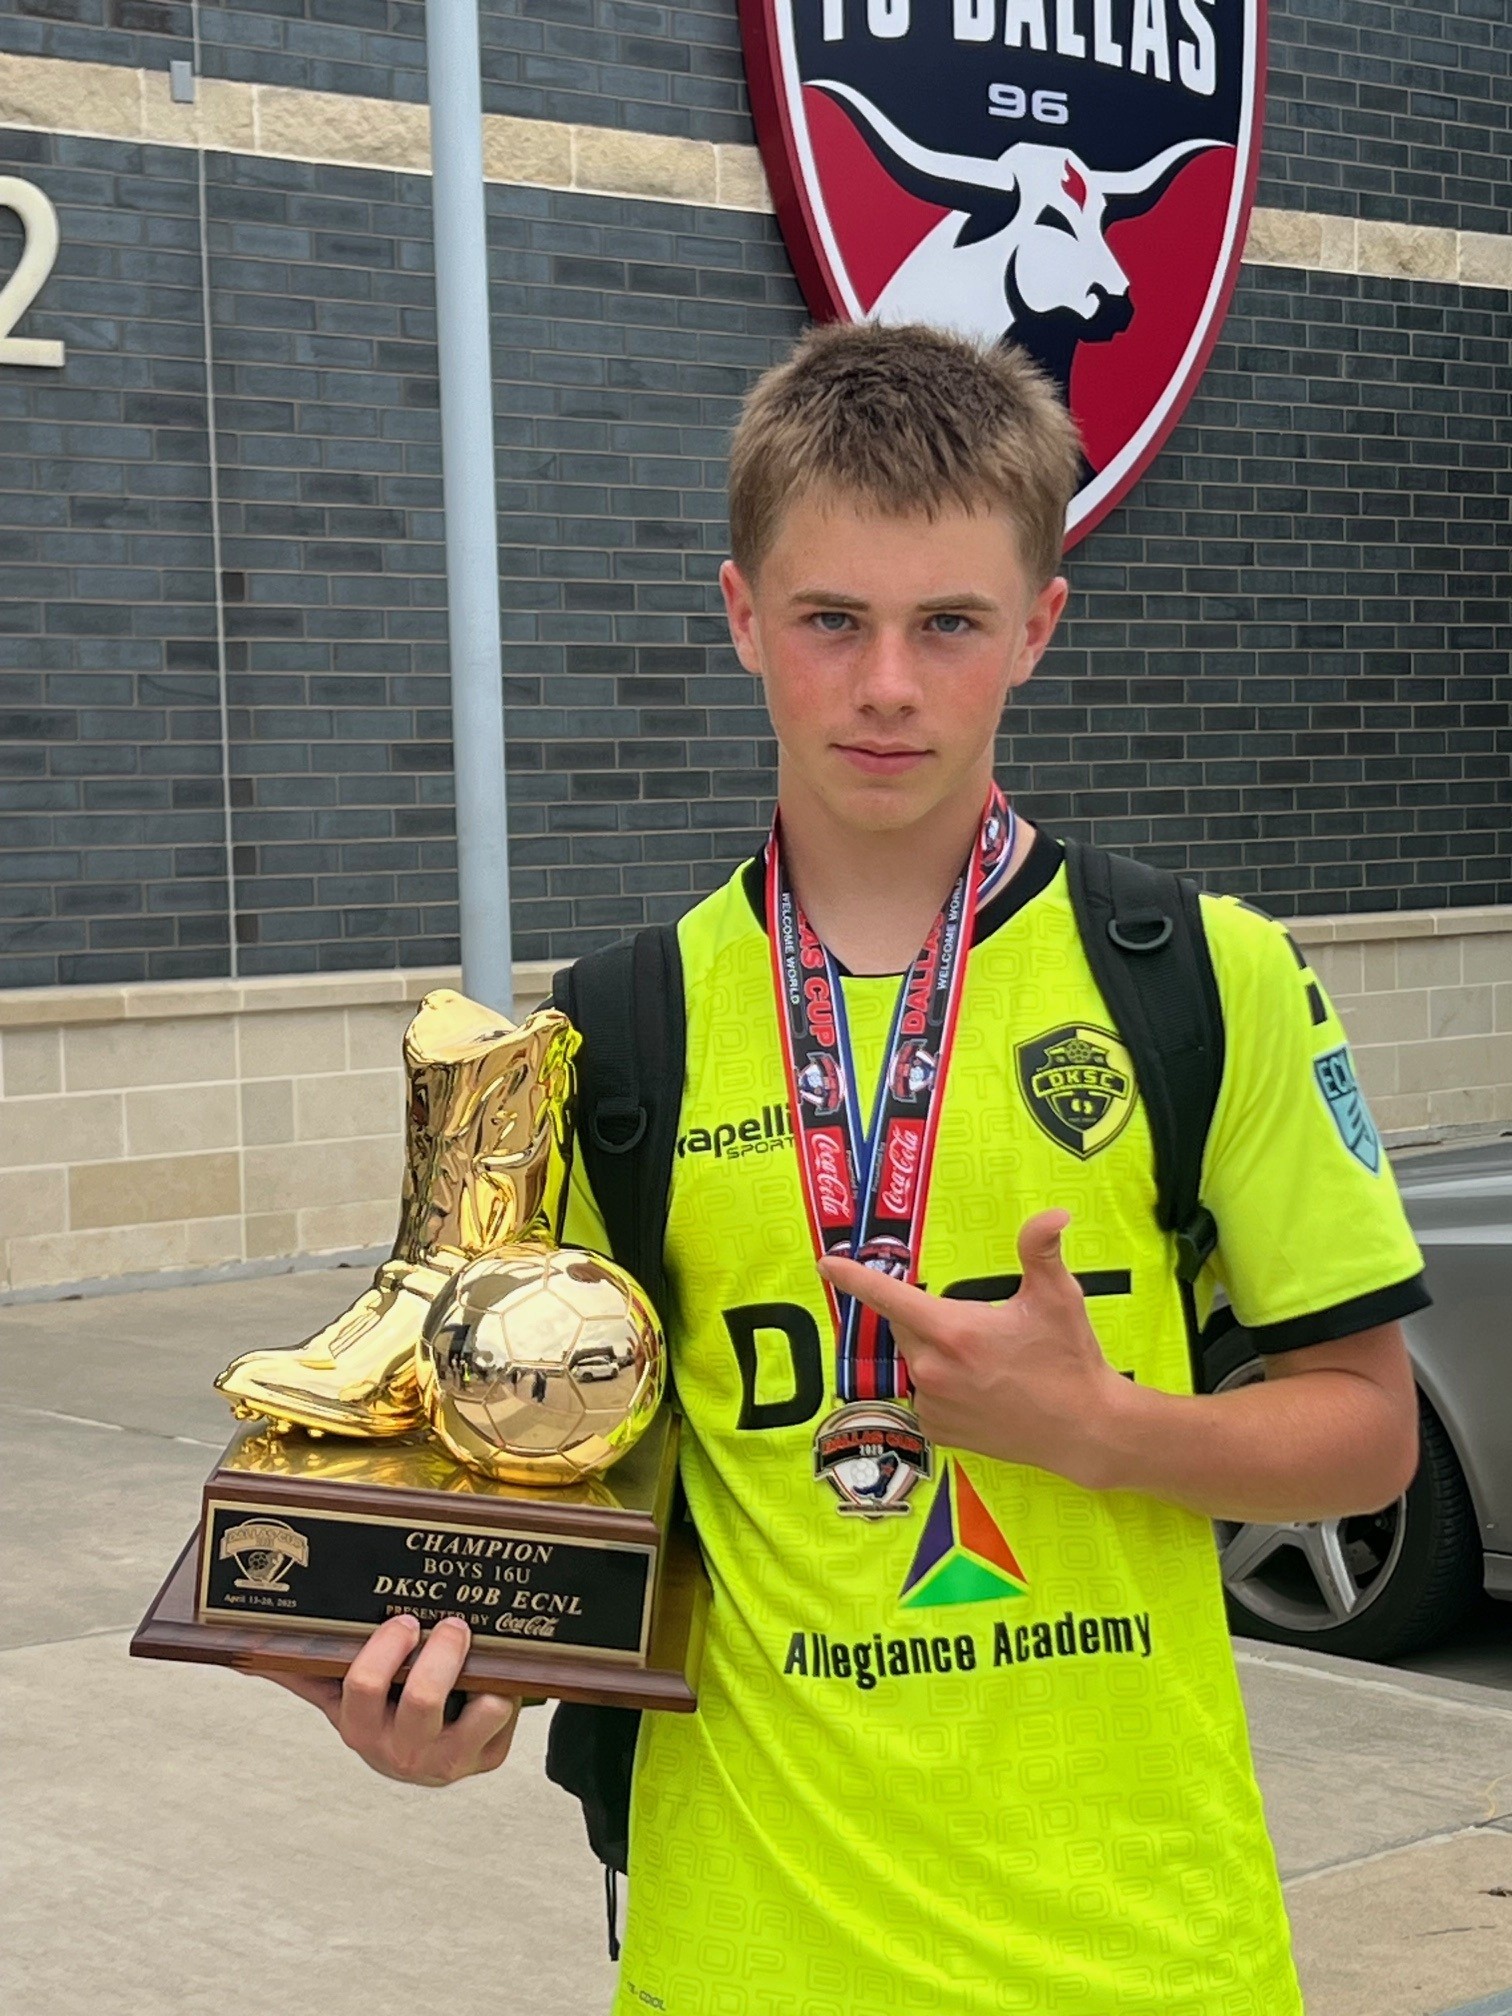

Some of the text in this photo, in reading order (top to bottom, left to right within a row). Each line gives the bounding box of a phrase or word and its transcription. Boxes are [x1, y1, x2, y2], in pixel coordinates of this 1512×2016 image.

[987, 82, 1069, 126] 96
[781, 891, 800, 1006] WELCOME WORLD
[936, 923, 957, 991] WELCOME
[803, 976, 836, 1048] CUP
[1047, 1070, 1115, 1088] DKSC
[405, 1531, 553, 1564] CHAMPION
[423, 1557, 531, 1584] BOYS 16U
[373, 1575, 583, 1616] DKSC 09B ECNL
[470, 1613, 490, 1627] BY
[783, 1611, 1153, 1691] Allegiance Academy
